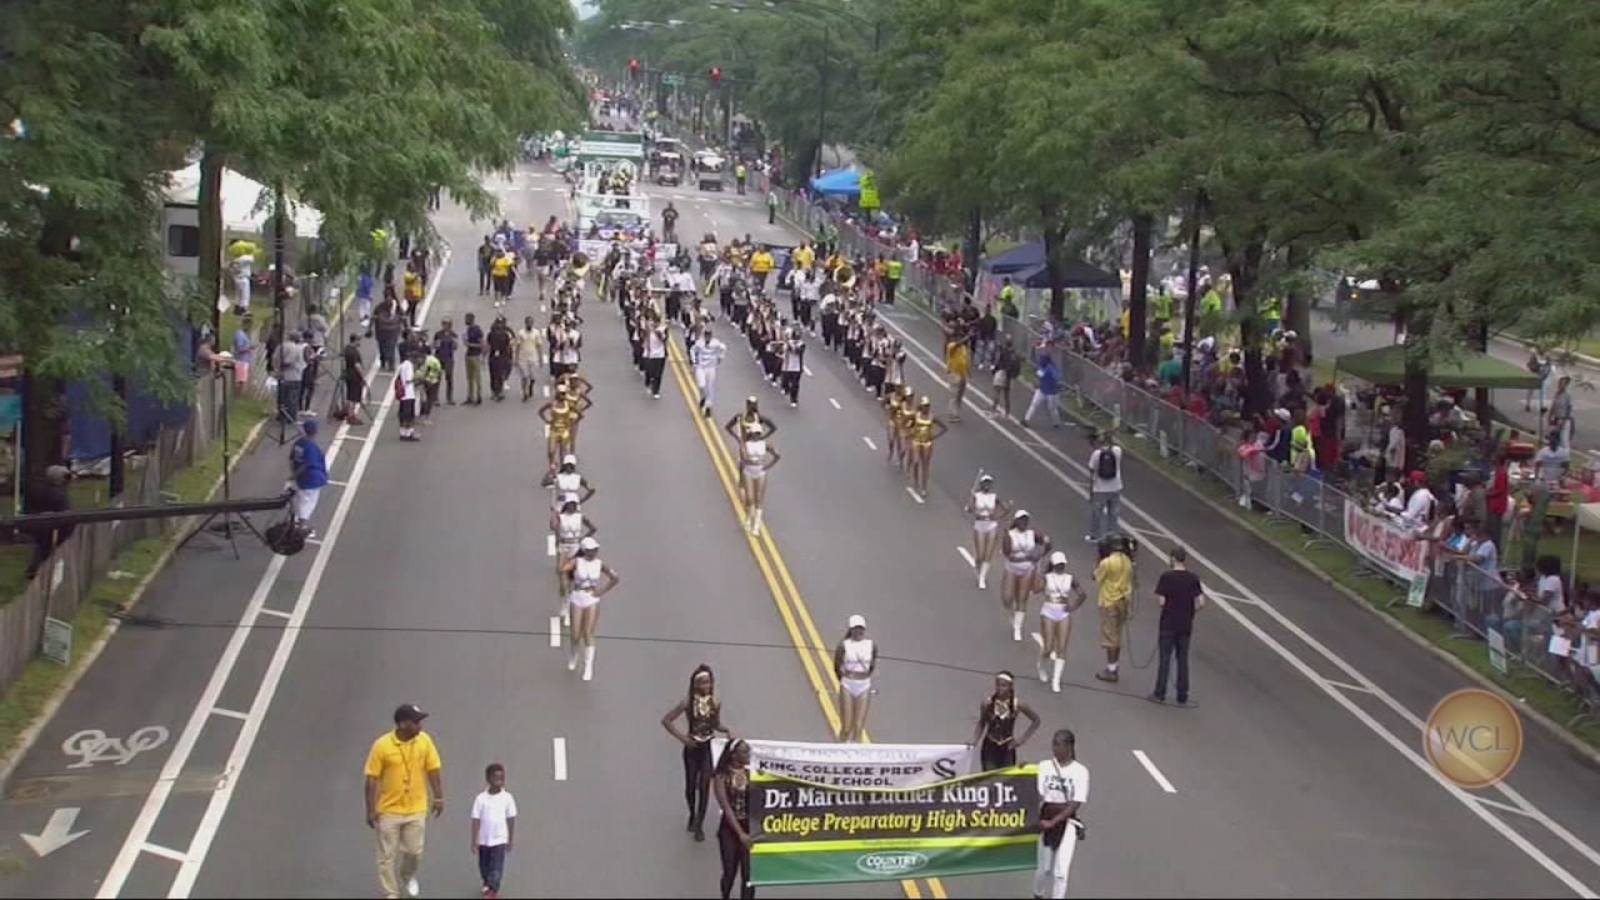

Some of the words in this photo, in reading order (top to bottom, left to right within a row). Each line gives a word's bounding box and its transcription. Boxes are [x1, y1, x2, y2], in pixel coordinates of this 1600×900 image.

[759, 761, 797, 772] KING
[802, 764, 875, 776] COLLEGE
[880, 766, 923, 776] PREP
[831, 777, 894, 786] SCHOOL
[763, 788, 793, 808] Dr.
[942, 783, 989, 807] King
[994, 782, 1018, 807] Jr.
[763, 814, 820, 836] College
[823, 812, 922, 834] Preparatory
[926, 810, 966, 831] High
[969, 808, 1026, 828] School
